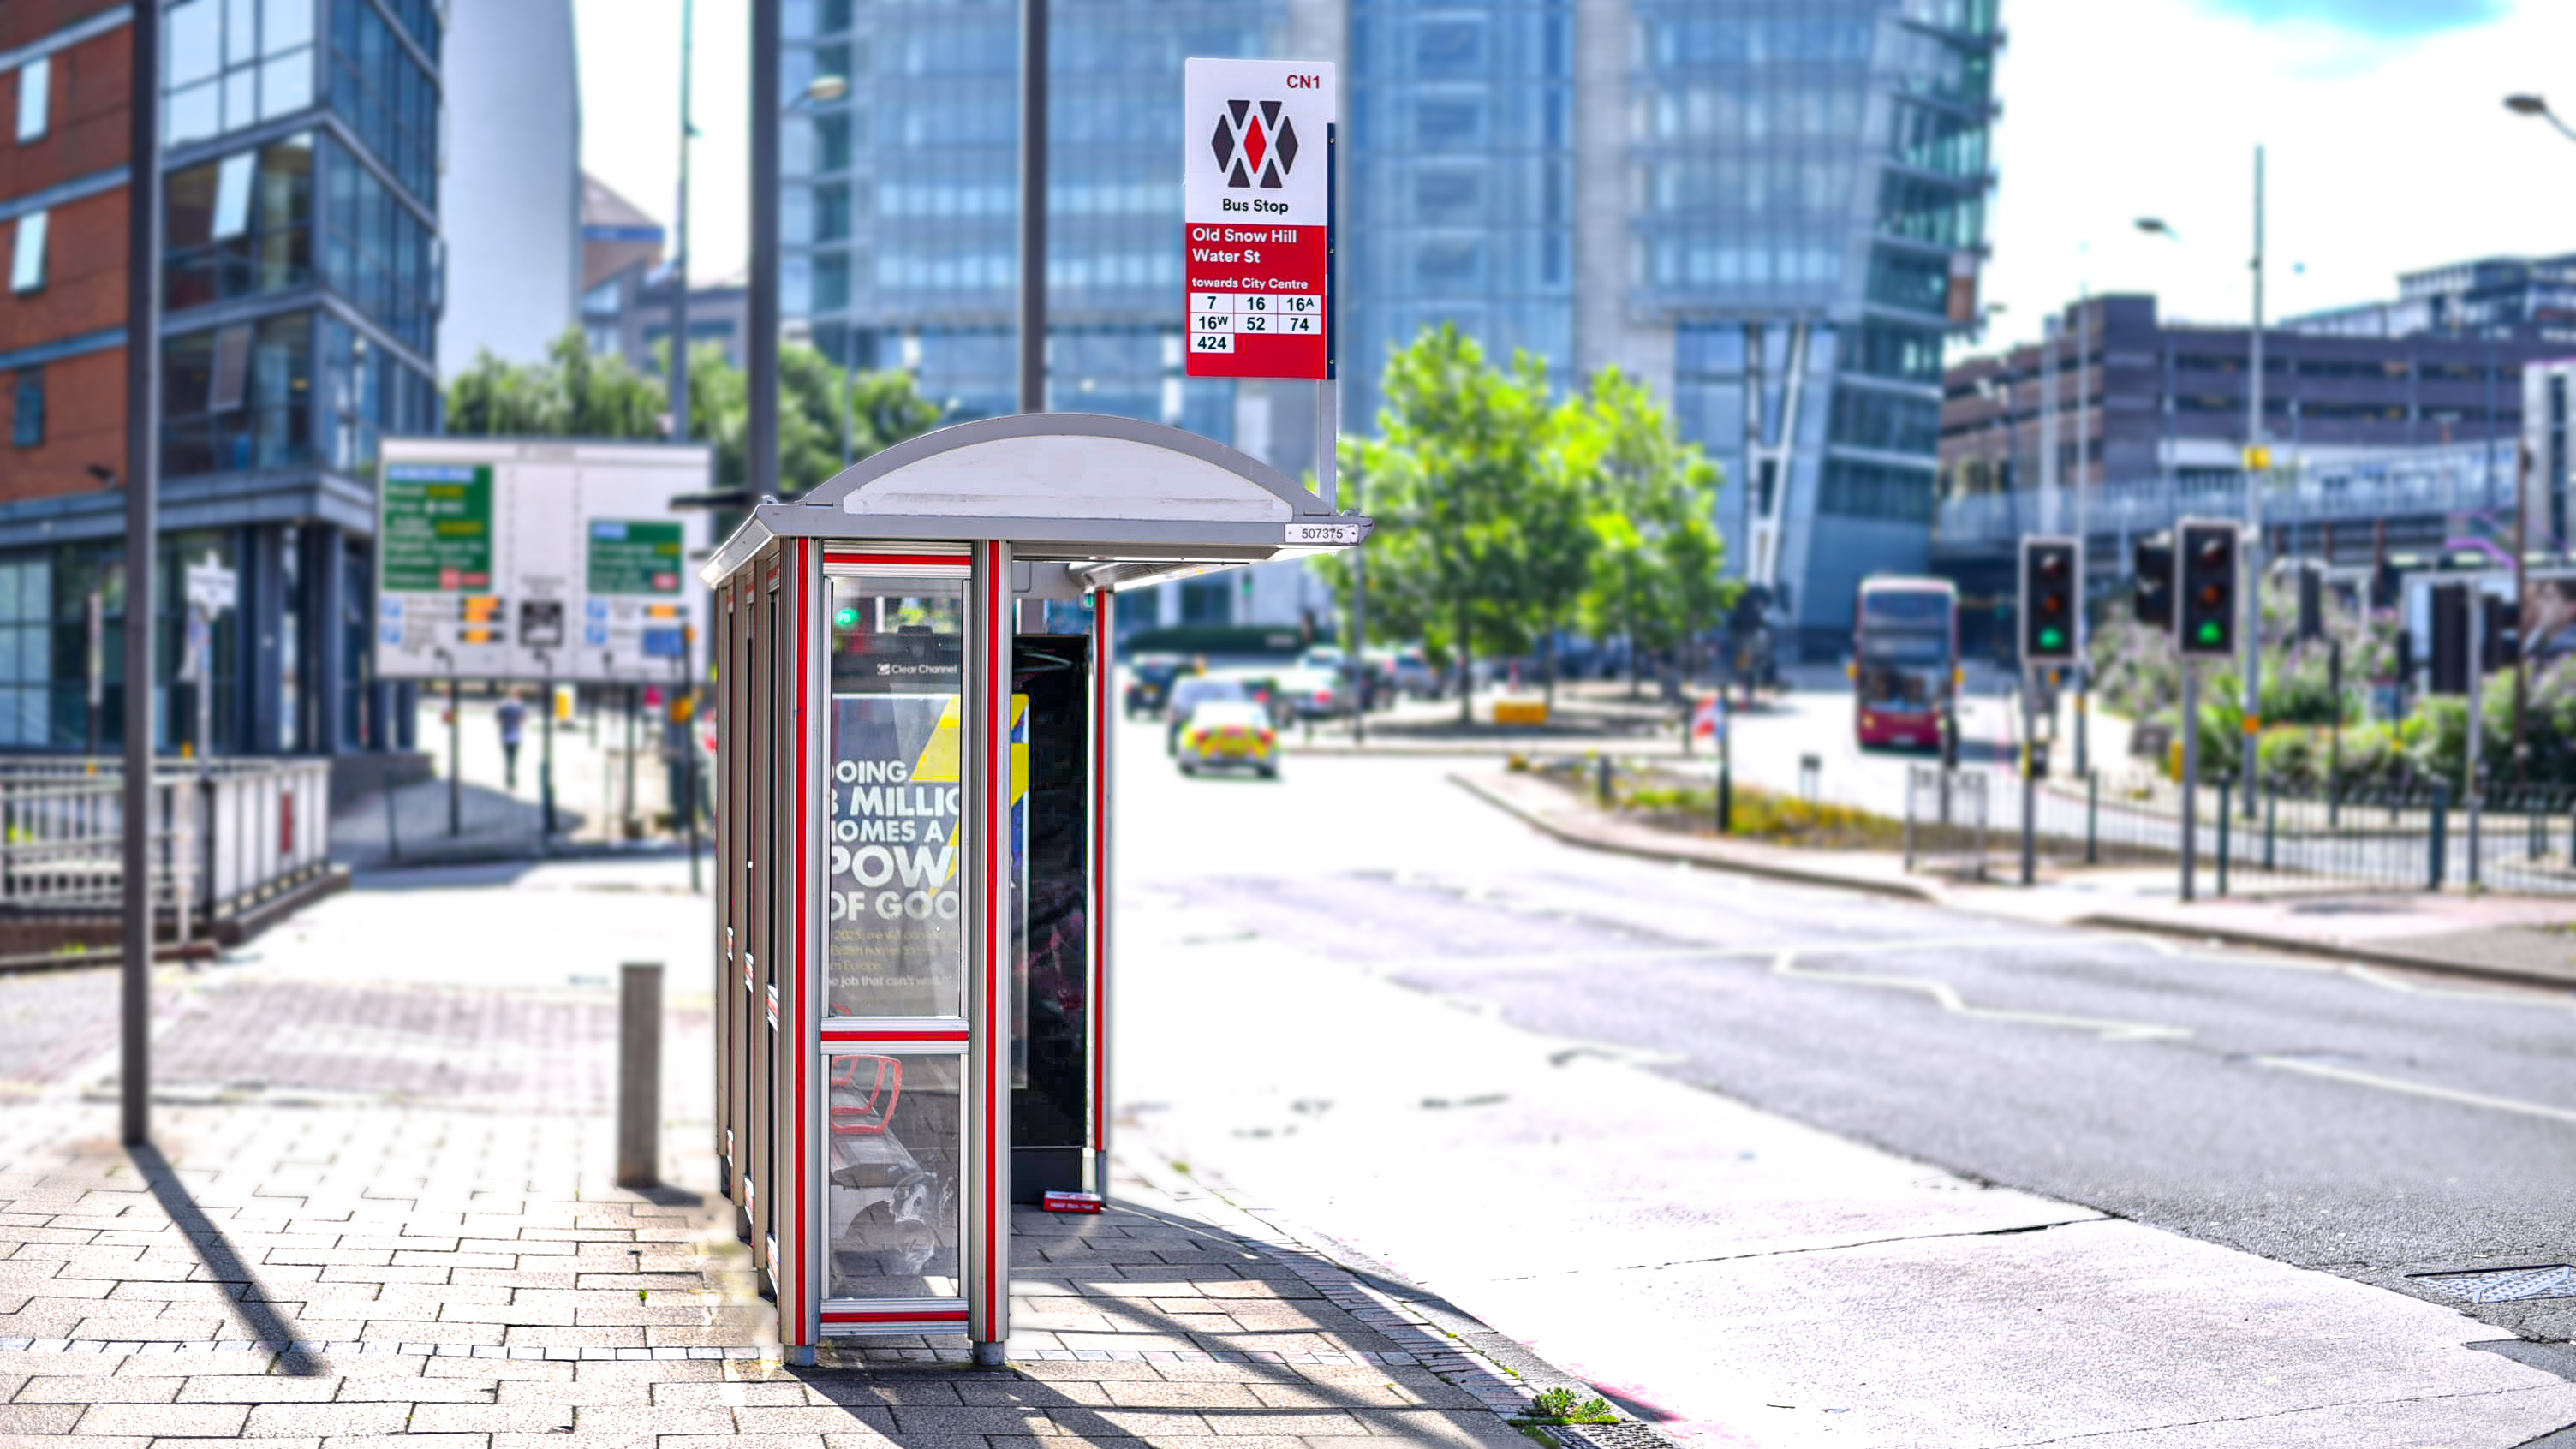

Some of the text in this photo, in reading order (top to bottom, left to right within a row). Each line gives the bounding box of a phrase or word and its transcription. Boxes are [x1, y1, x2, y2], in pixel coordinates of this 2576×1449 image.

[1286, 75, 1320, 89] CN1
[1222, 198, 1289, 215] Bus Stop
[1192, 228, 1297, 243] Old Snow Hill
[1192, 248, 1261, 263] Water St
[1191, 277, 1309, 290] towards City Centre
[1207, 296, 1217, 310] 7
[1246, 296, 1266, 311] 16
[1246, 317, 1266, 331] 52
[1290, 318, 1309, 331] 74
[1197, 336, 1227, 350] 424
[1301, 528, 1344, 540] 507375
[891, 664, 957, 674] Clear Channel
[831, 760, 908, 784] OING
[923, 820, 945, 843] A
[831, 844, 960, 888] POW
[875, 891, 960, 921] GOO
[840, 975, 859, 988] job
[861, 975, 883, 986] that
